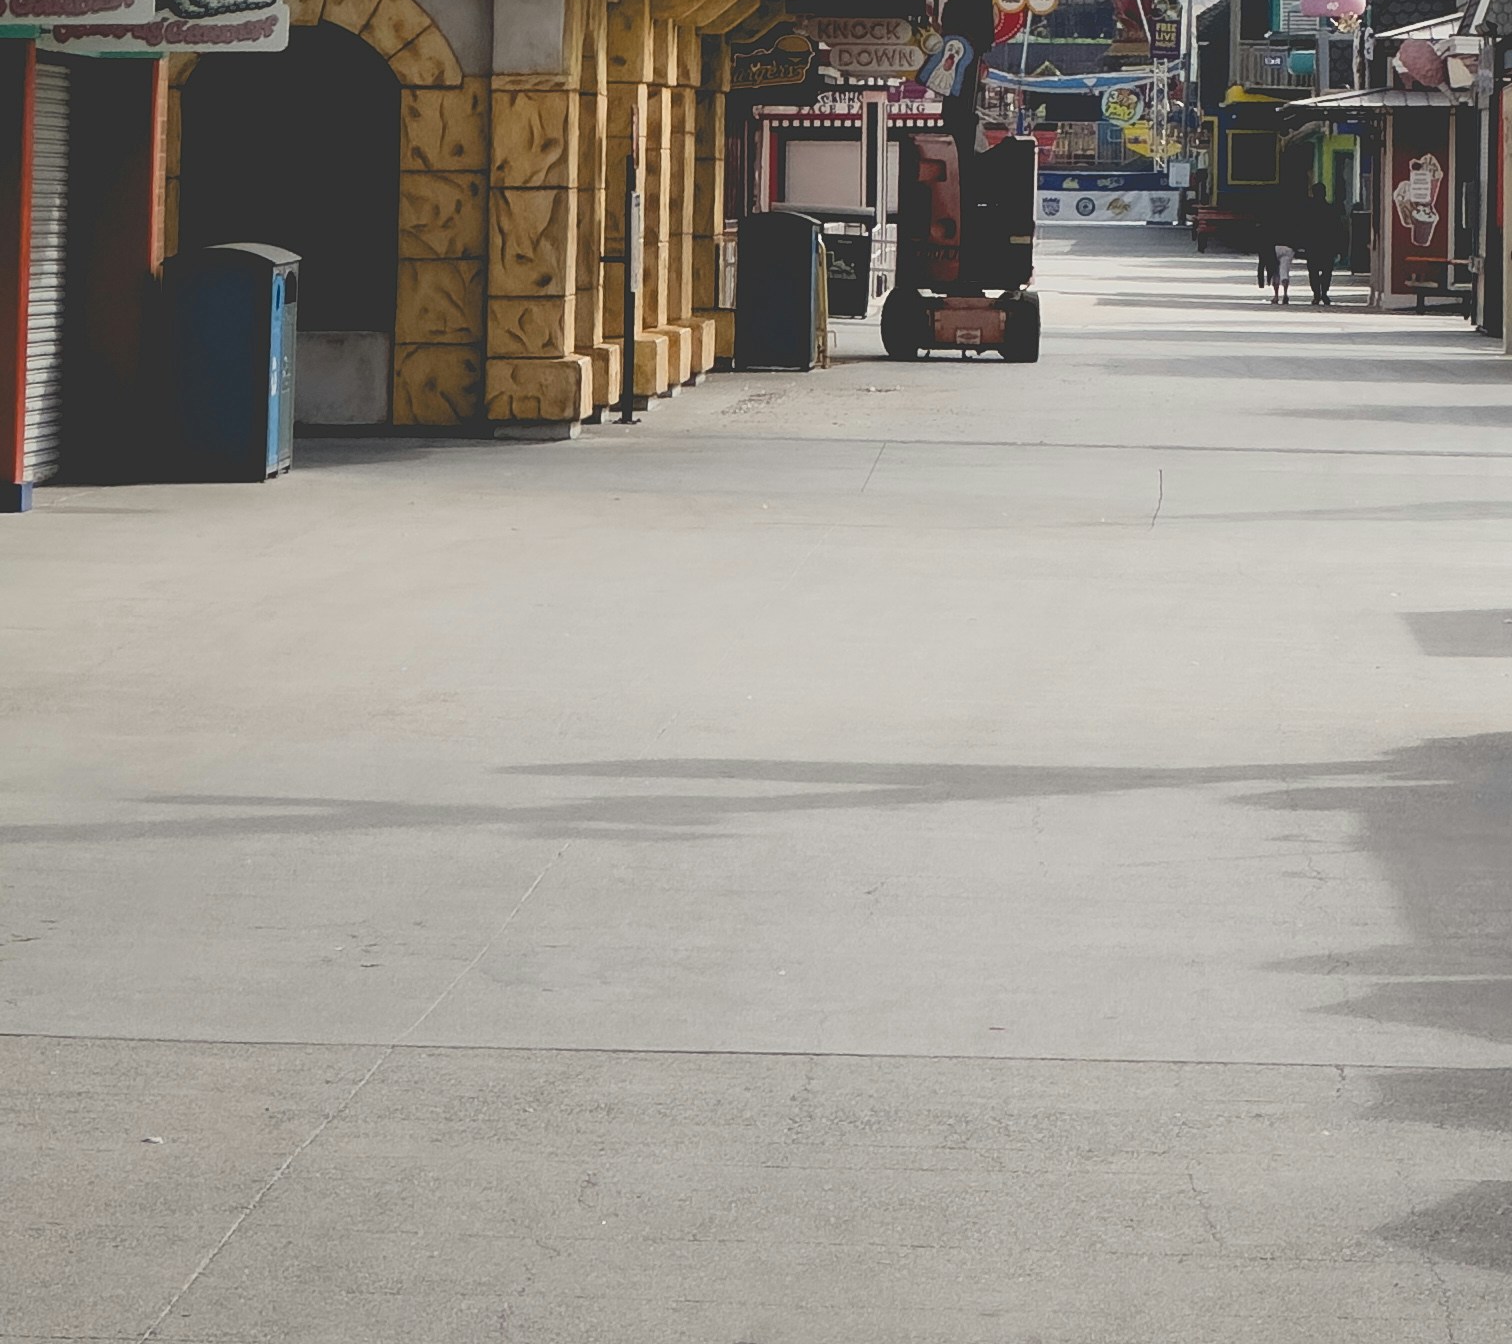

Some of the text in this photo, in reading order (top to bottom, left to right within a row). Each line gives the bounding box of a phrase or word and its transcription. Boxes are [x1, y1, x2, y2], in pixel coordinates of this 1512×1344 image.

[816, 22, 900, 41] KNOCK
[1155, 32, 1177, 41] LIVE
[837, 49, 914, 68] DOWN
